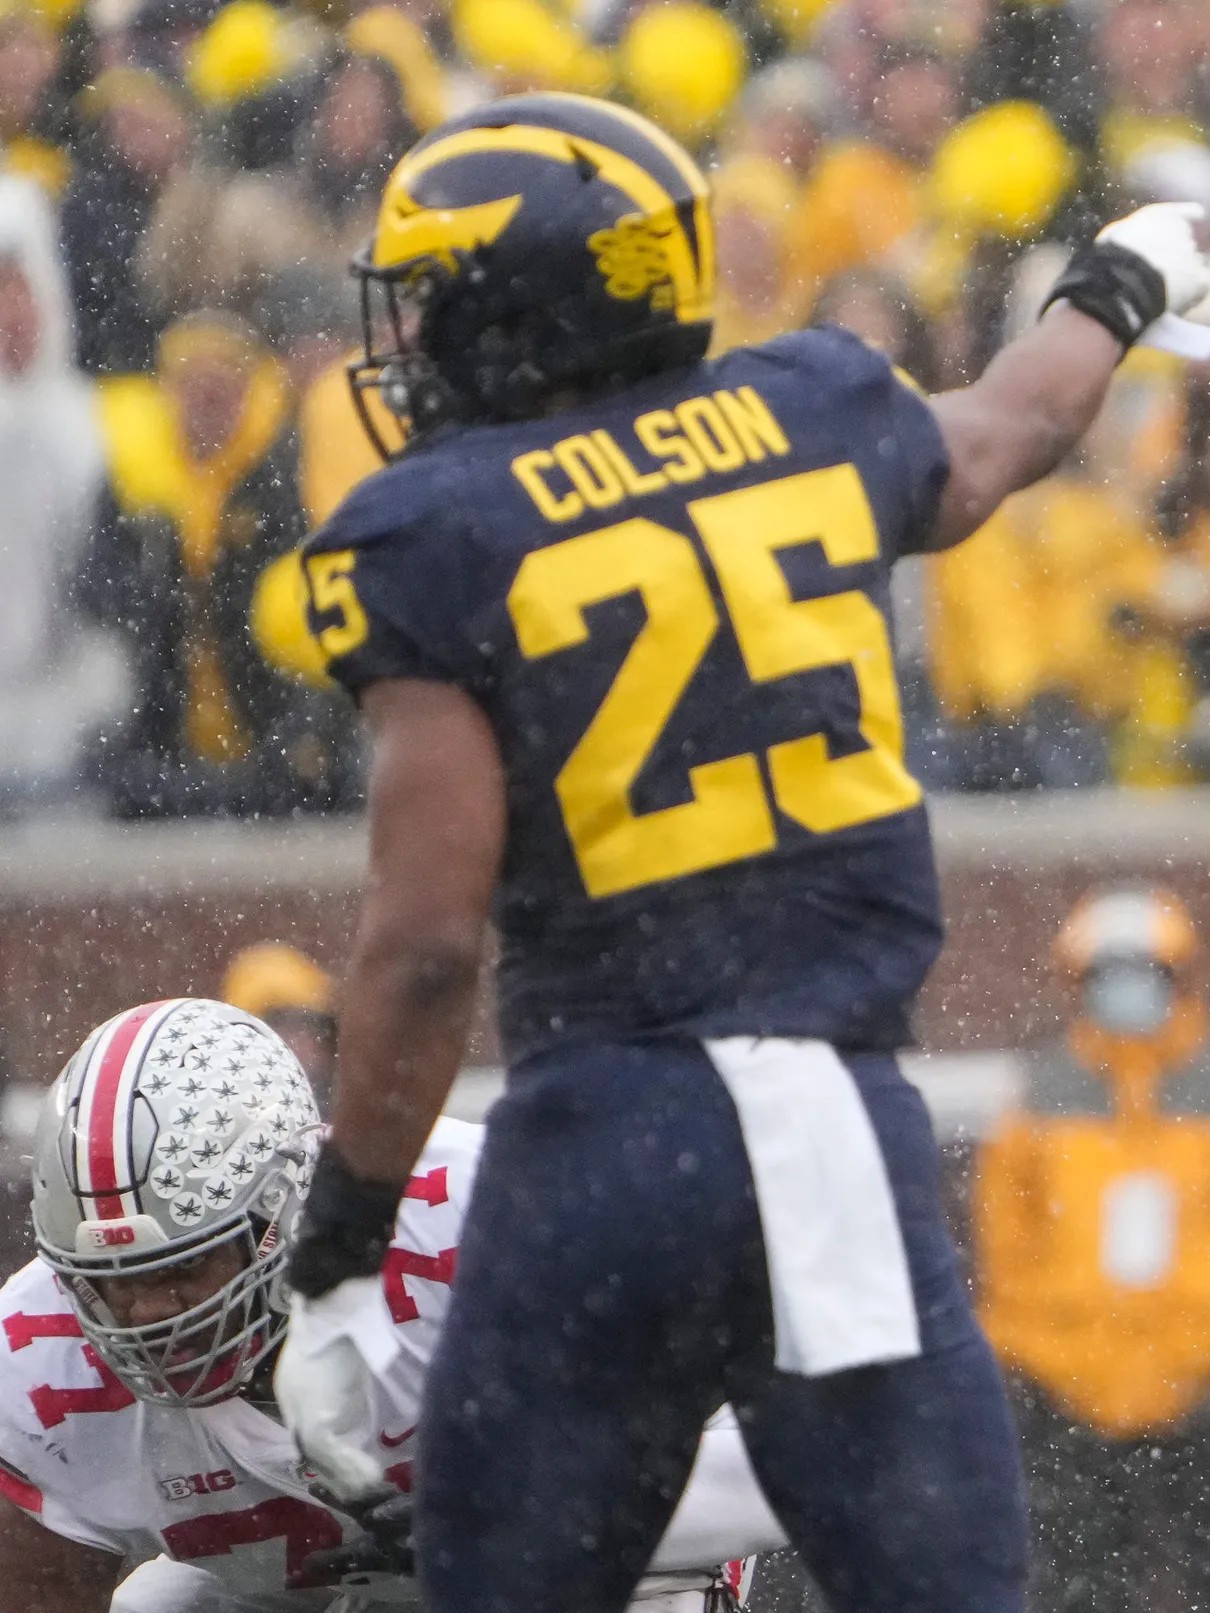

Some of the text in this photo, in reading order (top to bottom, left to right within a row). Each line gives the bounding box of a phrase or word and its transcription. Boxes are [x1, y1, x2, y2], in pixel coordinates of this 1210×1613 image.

[511, 384, 790, 522] COLSON
[309, 549, 369, 656] 5
[507, 462, 922, 898] 25
